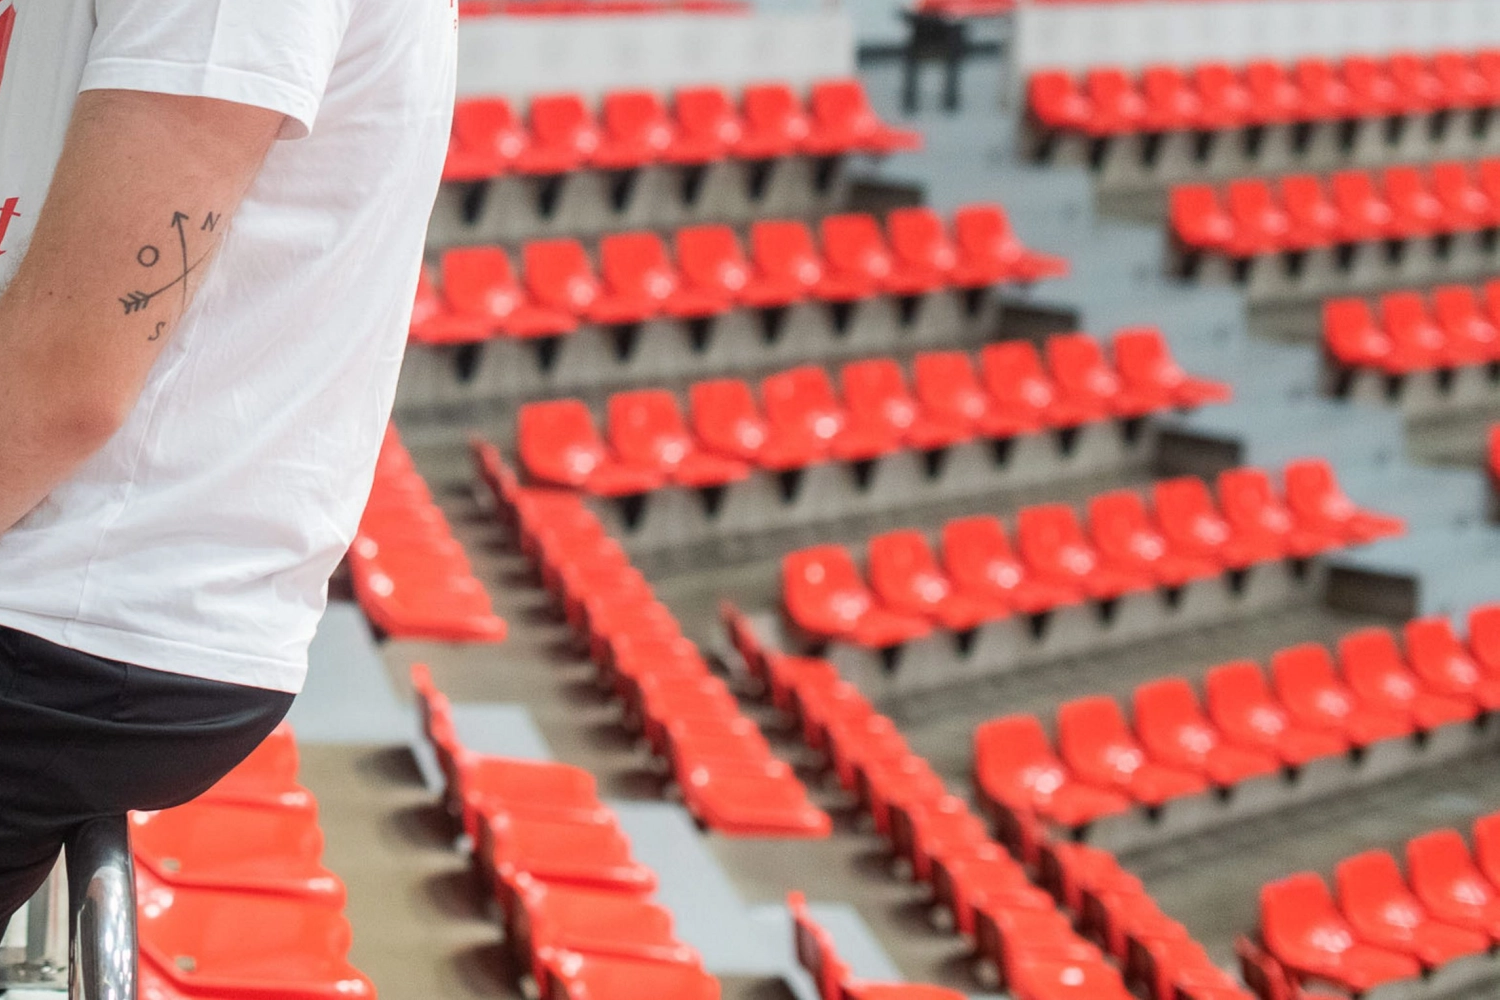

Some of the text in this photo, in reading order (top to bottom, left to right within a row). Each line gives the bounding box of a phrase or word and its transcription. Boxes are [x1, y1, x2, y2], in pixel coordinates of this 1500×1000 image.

[201, 211, 222, 232] N
[137, 245, 160, 267] O
[147, 321, 166, 341] S
